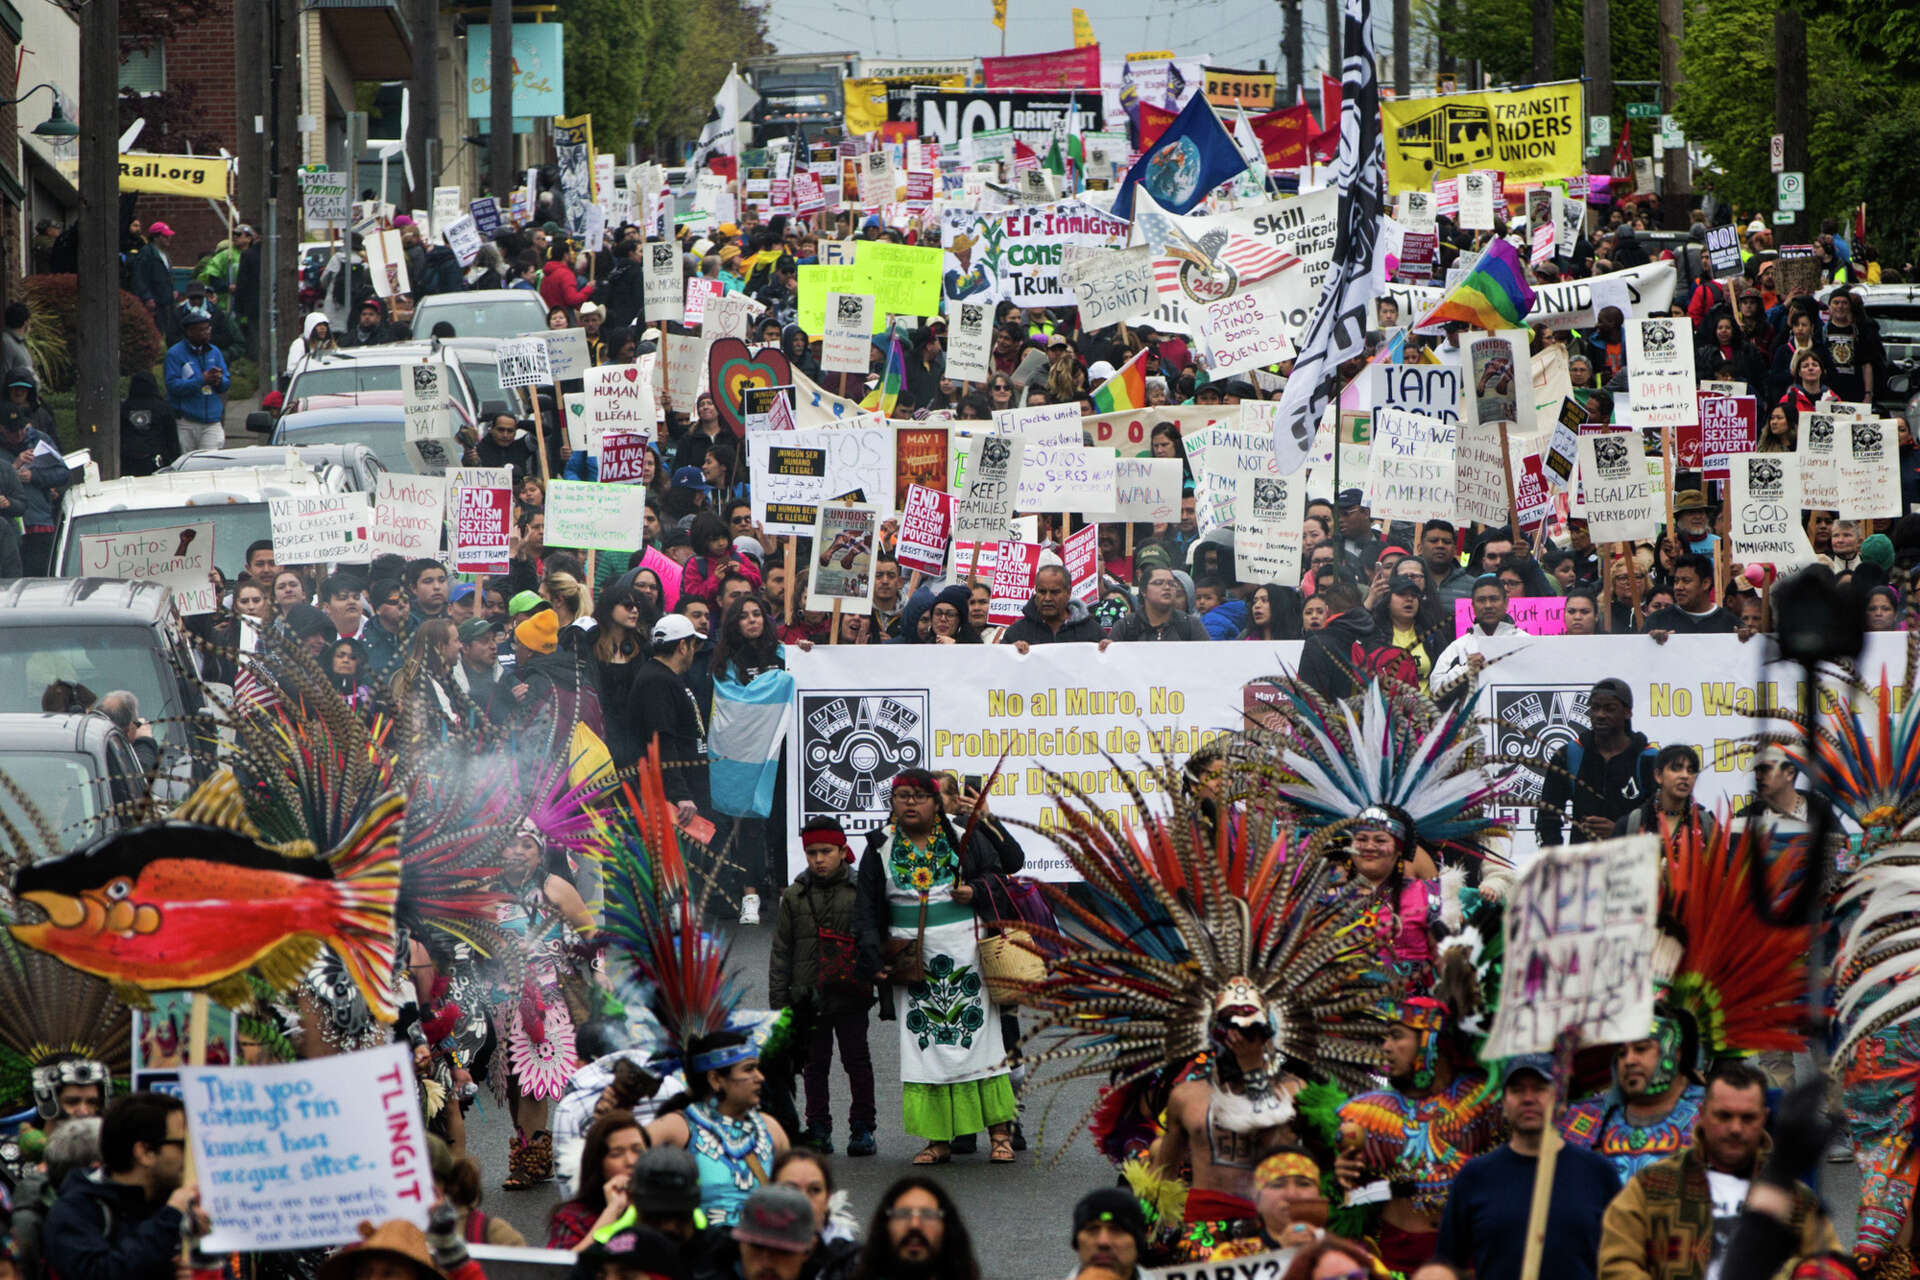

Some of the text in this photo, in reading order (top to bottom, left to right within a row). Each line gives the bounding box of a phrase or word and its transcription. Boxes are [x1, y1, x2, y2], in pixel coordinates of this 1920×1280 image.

[1208, 81, 1272, 98] RESIST
[1494, 96, 1570, 119] TRANSIT
[1496, 115, 1572, 142] RIDERS
[1499, 140, 1556, 161] UNION
[305, 174, 337, 184] MAKE
[307, 197, 341, 208] GREAT
[308, 207, 346, 218] AGAIN
[1253, 206, 1306, 236] Skill
[1706, 226, 1737, 251] NO!
[1303, 260, 1330, 274] into
[690, 280, 712, 291] END
[1080, 264, 1152, 300] DESERVE
[1193, 278, 1224, 295] 242
[602, 372, 622, 383] NO
[594, 386, 639, 399] HUMAN
[608, 401, 620, 410] IS
[1706, 400, 1738, 418] END
[595, 411, 642, 422] ILLEGAL
[1704, 418, 1748, 429] RACISM
[907, 434, 928, 443] MAY
[1212, 431, 1242, 450] BAN
[1704, 429, 1748, 441] SEXISM
[1457, 446, 1472, 459] NO
[1704, 440, 1756, 452] POVERTY
[603, 447, 644, 463] NI UNA
[1238, 454, 1263, 471] NOT
[1704, 458, 1729, 467] RESIST
[602, 459, 643, 480] MAS
[1383, 459, 1443, 481] RESIST
[1457, 464, 1501, 486] WAY TO
[379, 480, 437, 506] Juntos
[462, 490, 493, 508] END
[910, 488, 940, 510] END
[969, 481, 1007, 500] KEEP
[1117, 486, 1166, 505] WALL
[1385, 484, 1455, 504] AMERICA
[1456, 480, 1500, 503] DETAIN
[1585, 482, 1649, 504] LEGALIZE
[271, 497, 346, 517] WE DID NOT
[460, 508, 502, 521] RACISM
[830, 510, 867, 520] UNIDOS
[908, 505, 945, 523] RACISM
[959, 500, 1007, 516] FAMILIES
[1455, 496, 1508, 522] FAMILIES
[1742, 503, 1788, 522] GOD
[957, 516, 1007, 532] TOGETHER
[1587, 508, 1650, 524] EVERYBODY!
[459, 520, 502, 534] SEXISM
[905, 516, 943, 534] SEXISM
[1743, 522, 1787, 535] LOVES
[274, 531, 342, 549] BORDER THE
[372, 529, 421, 549] unidos
[458, 532, 509, 547] POVERTY
[903, 526, 948, 550] POVERTY
[94, 536, 168, 569] Juntos
[458, 550, 508, 560] RESIST TRUMP
[922, 549, 944, 561] TRUMP
[1000, 542, 1026, 561] END
[1735, 541, 1796, 554] IMMIGRANTS
[997, 560, 1031, 574] RACISM
[995, 573, 1030, 586] SEXISM
[993, 585, 1036, 598] POVERTY
[990, 602, 1016, 611] RESIST
[988, 686, 1185, 718] No al Muro, No
[1254, 691, 1275, 703] May
[1650, 682, 1692, 717] No
[935, 726, 1099, 758] Prohibición
[1106, 726, 1140, 755] de
[377, 1063, 422, 1203] TLINGIT
